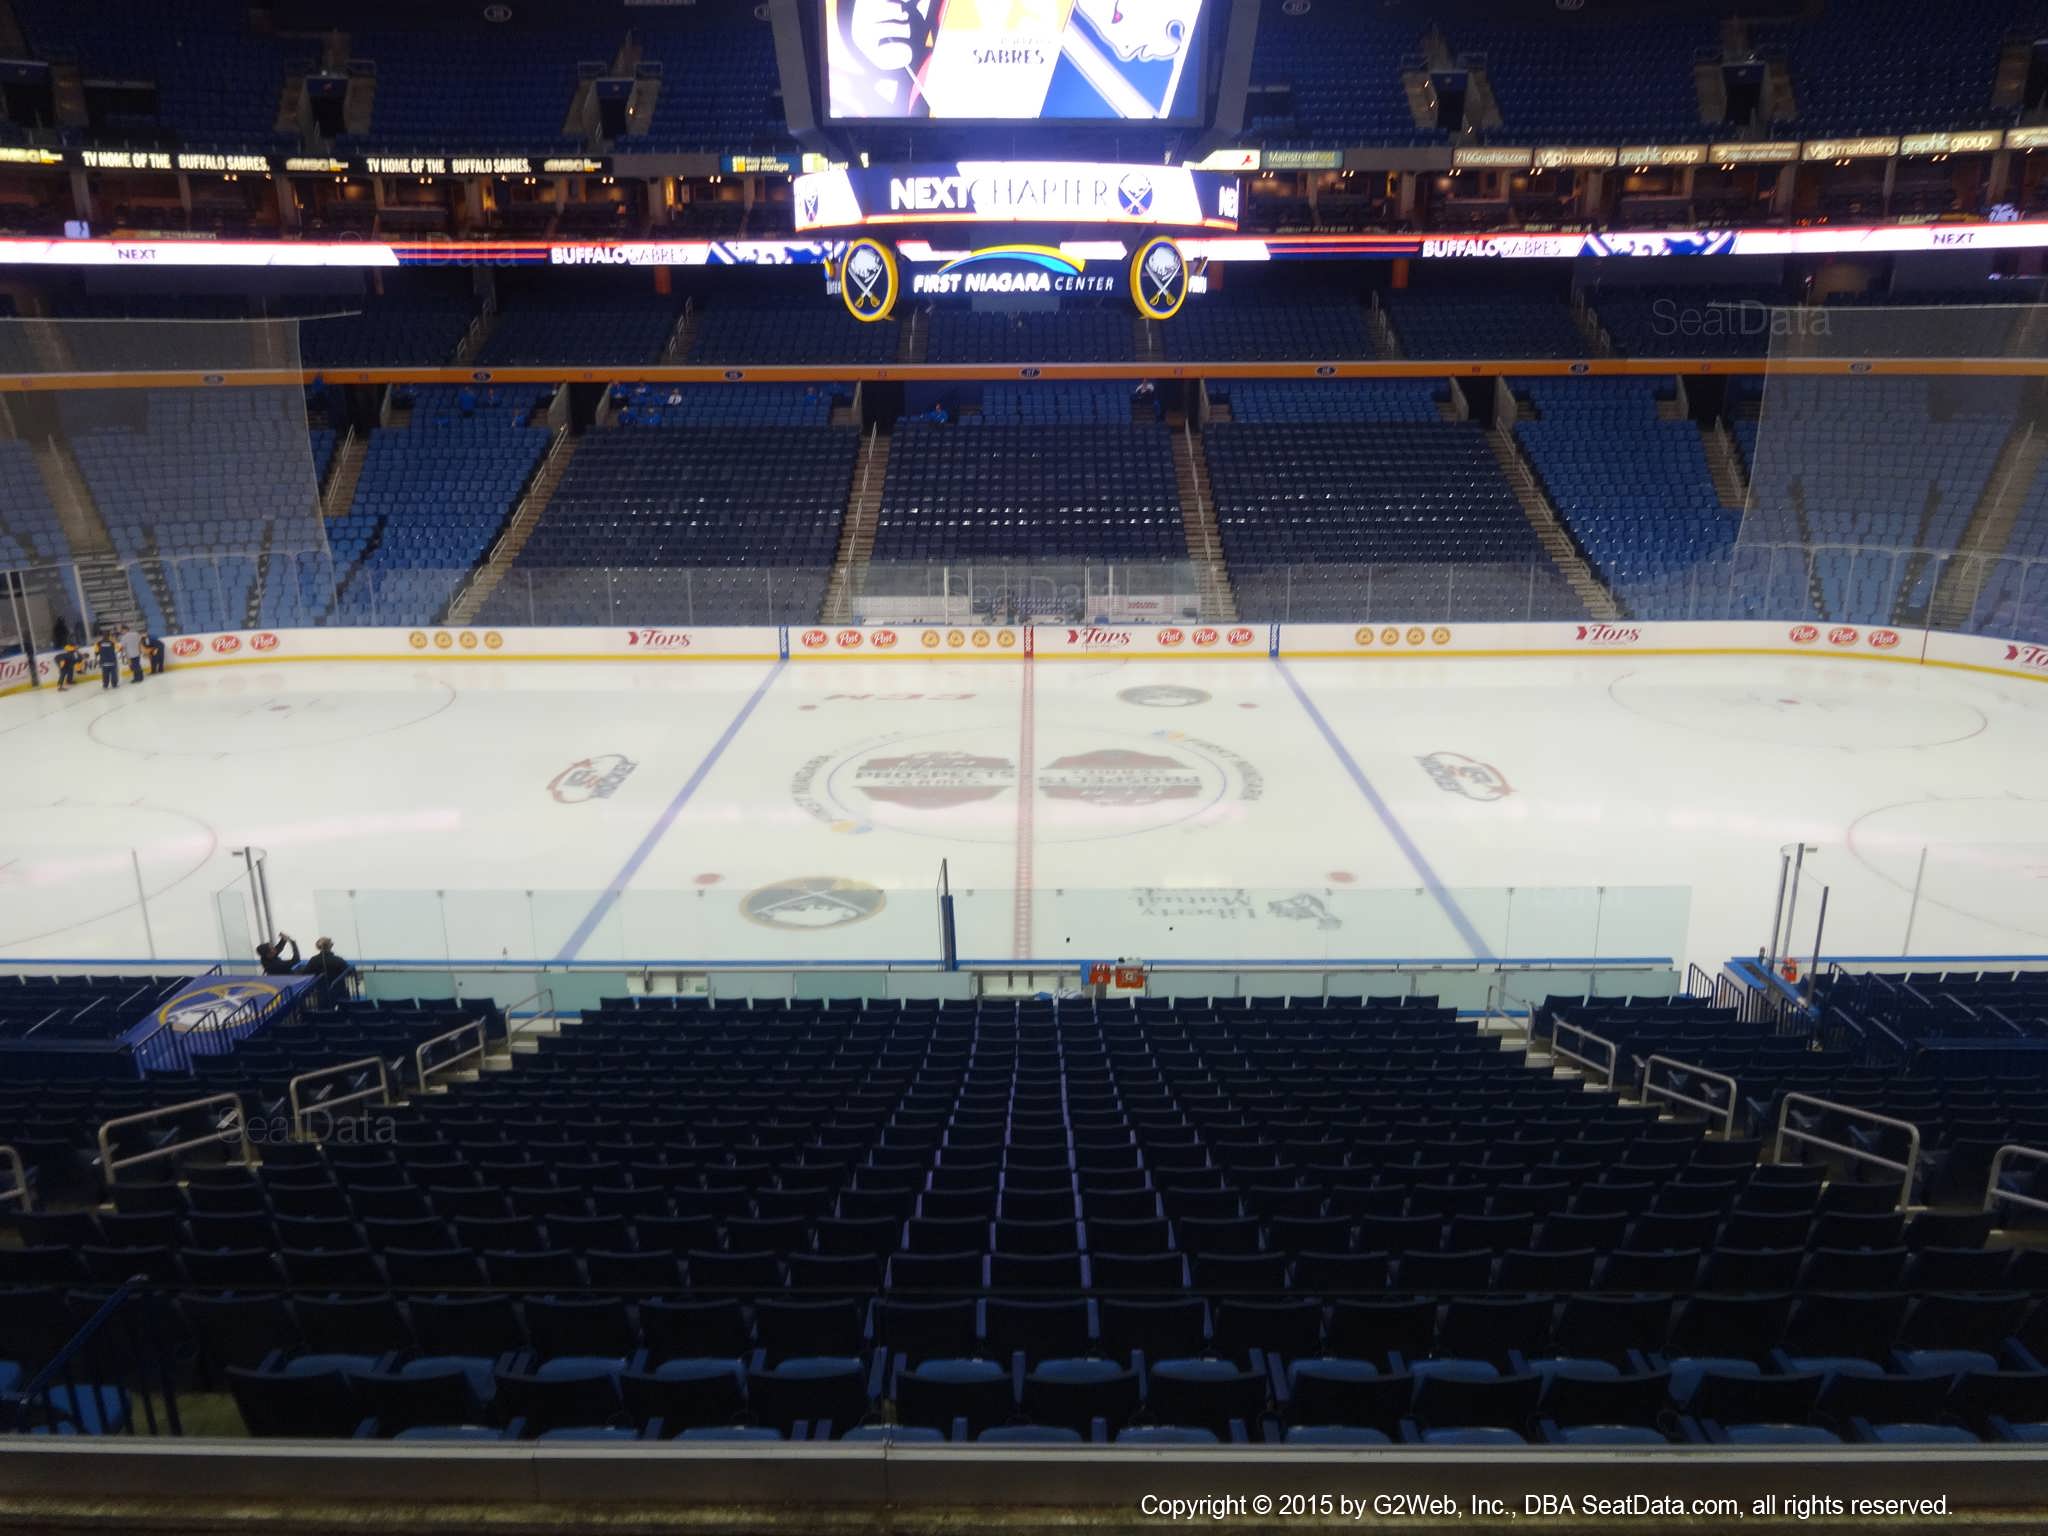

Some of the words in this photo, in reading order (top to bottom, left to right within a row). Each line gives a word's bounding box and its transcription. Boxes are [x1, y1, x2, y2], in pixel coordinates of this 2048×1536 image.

[972, 48, 1045, 64] SABRES
[1834, 138, 1898, 157] marketing
[1950, 135, 1992, 153] group
[82, 151, 98, 167] TV
[99, 152, 131, 168] HOME
[132, 153, 147, 168] OF
[149, 153, 171, 169] THE
[178, 154, 225, 170] BUFFALO
[1563, 147, 1617, 167] marketing
[1662, 149, 1699, 165] group
[367, 158, 381, 173] TV
[381, 158, 410, 173] HOME
[411, 159, 425, 173] OF
[426, 159, 446, 173] THE
[452, 158, 493, 173] BUFFALO
[890, 177, 968, 210] NEXT
[1933, 232, 1976, 246] NEXT
[118, 249, 157, 261] NEXT
[551, 245, 628, 265] BUFFALO
[1422, 239, 1500, 258] BUFFALO
[913, 273, 962, 293] FIRST
[964, 272, 1050, 293] NIAGARA
[1053, 275, 1115, 292] CENTER
[252, 633, 277, 648] Post
[804, 631, 826, 644] Post
[838, 631, 860, 644] Post
[873, 630, 895, 644] Post
[1159, 629, 1181, 644] Post
[1194, 629, 1216, 644] Post
[1229, 629, 1251, 643] Post
[1791, 626, 1817, 642] Post
[1830, 628, 1855, 643] Post
[1870, 630, 1895, 646] Post
[174, 640, 201, 654] Post
[213, 636, 240, 652] Post
